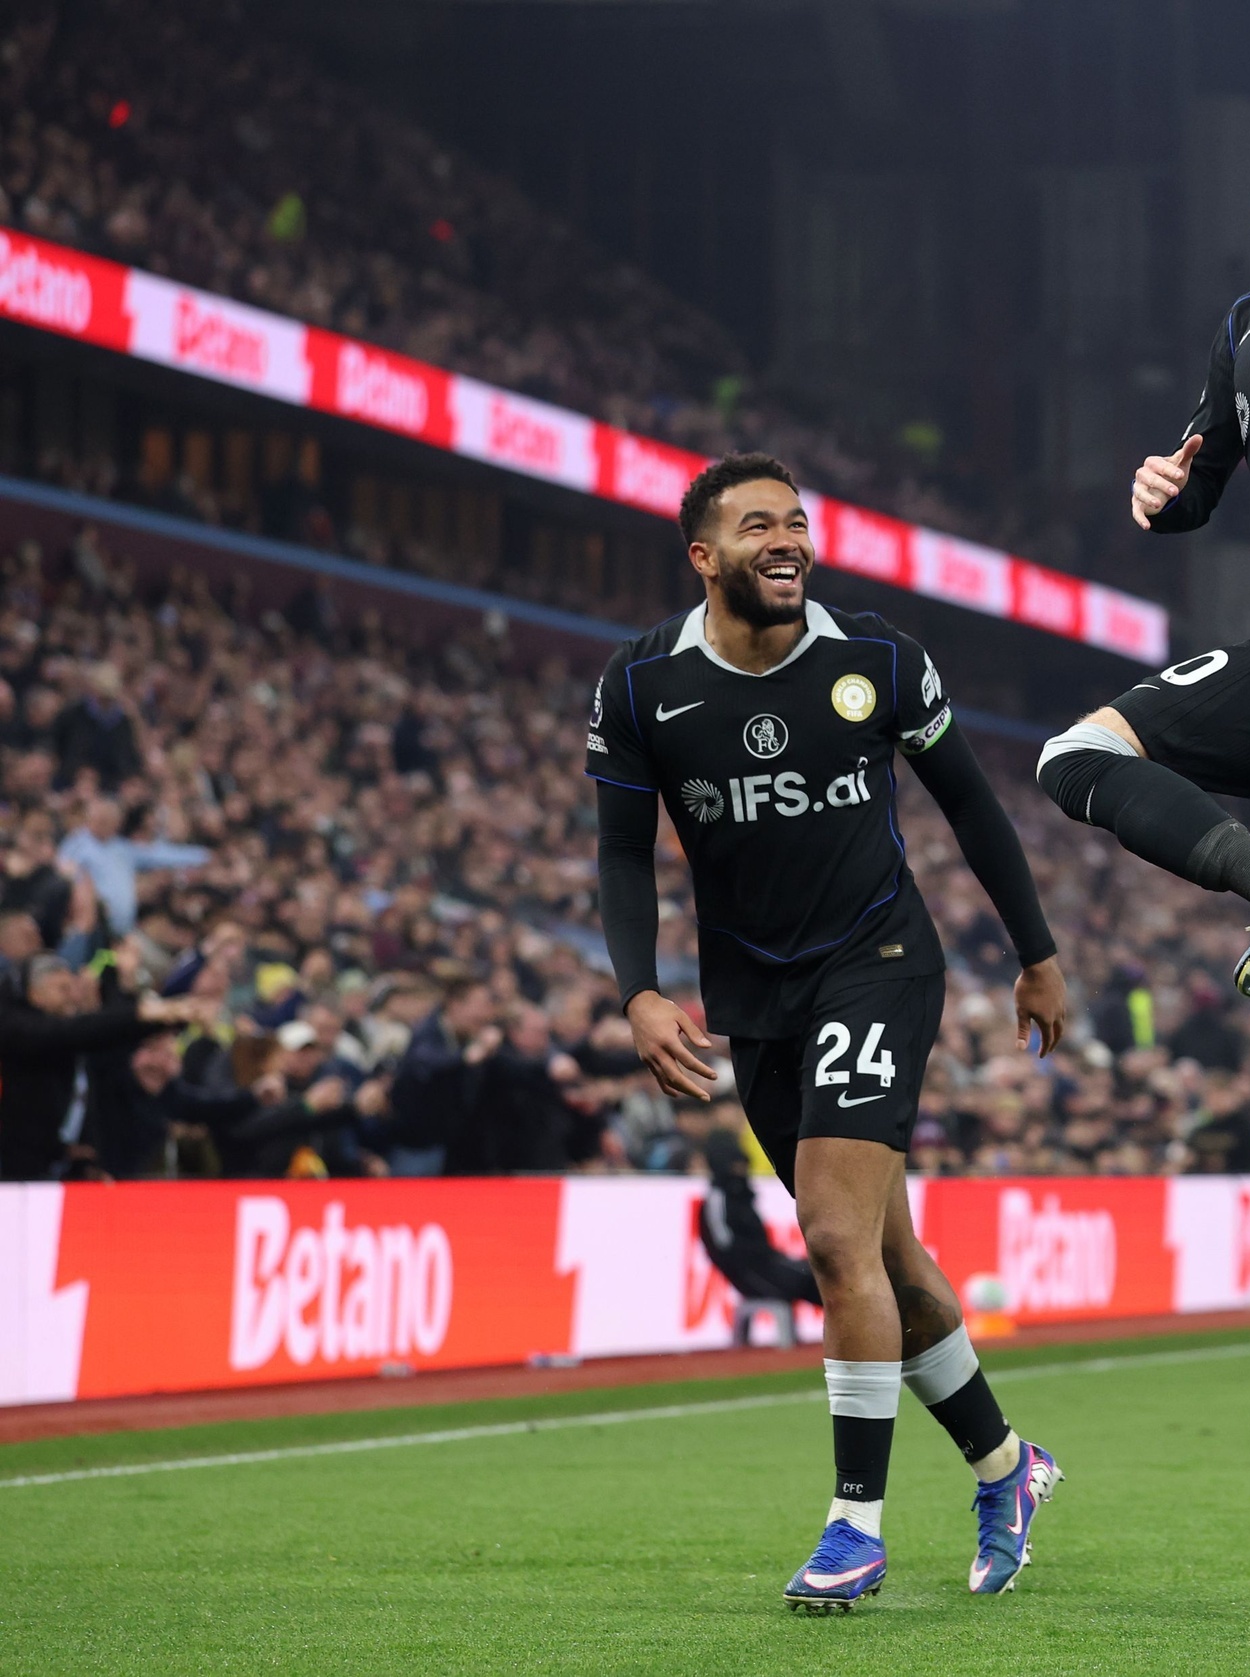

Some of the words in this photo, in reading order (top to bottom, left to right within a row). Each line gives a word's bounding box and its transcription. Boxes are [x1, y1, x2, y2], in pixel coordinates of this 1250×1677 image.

[847, 709, 863, 718] FIFA
[729, 756, 871, 822] IFS.ai
[815, 1022, 896, 1088] 24
[229, 1196, 453, 1370] Betano
[842, 1482, 864, 1495] CFC
